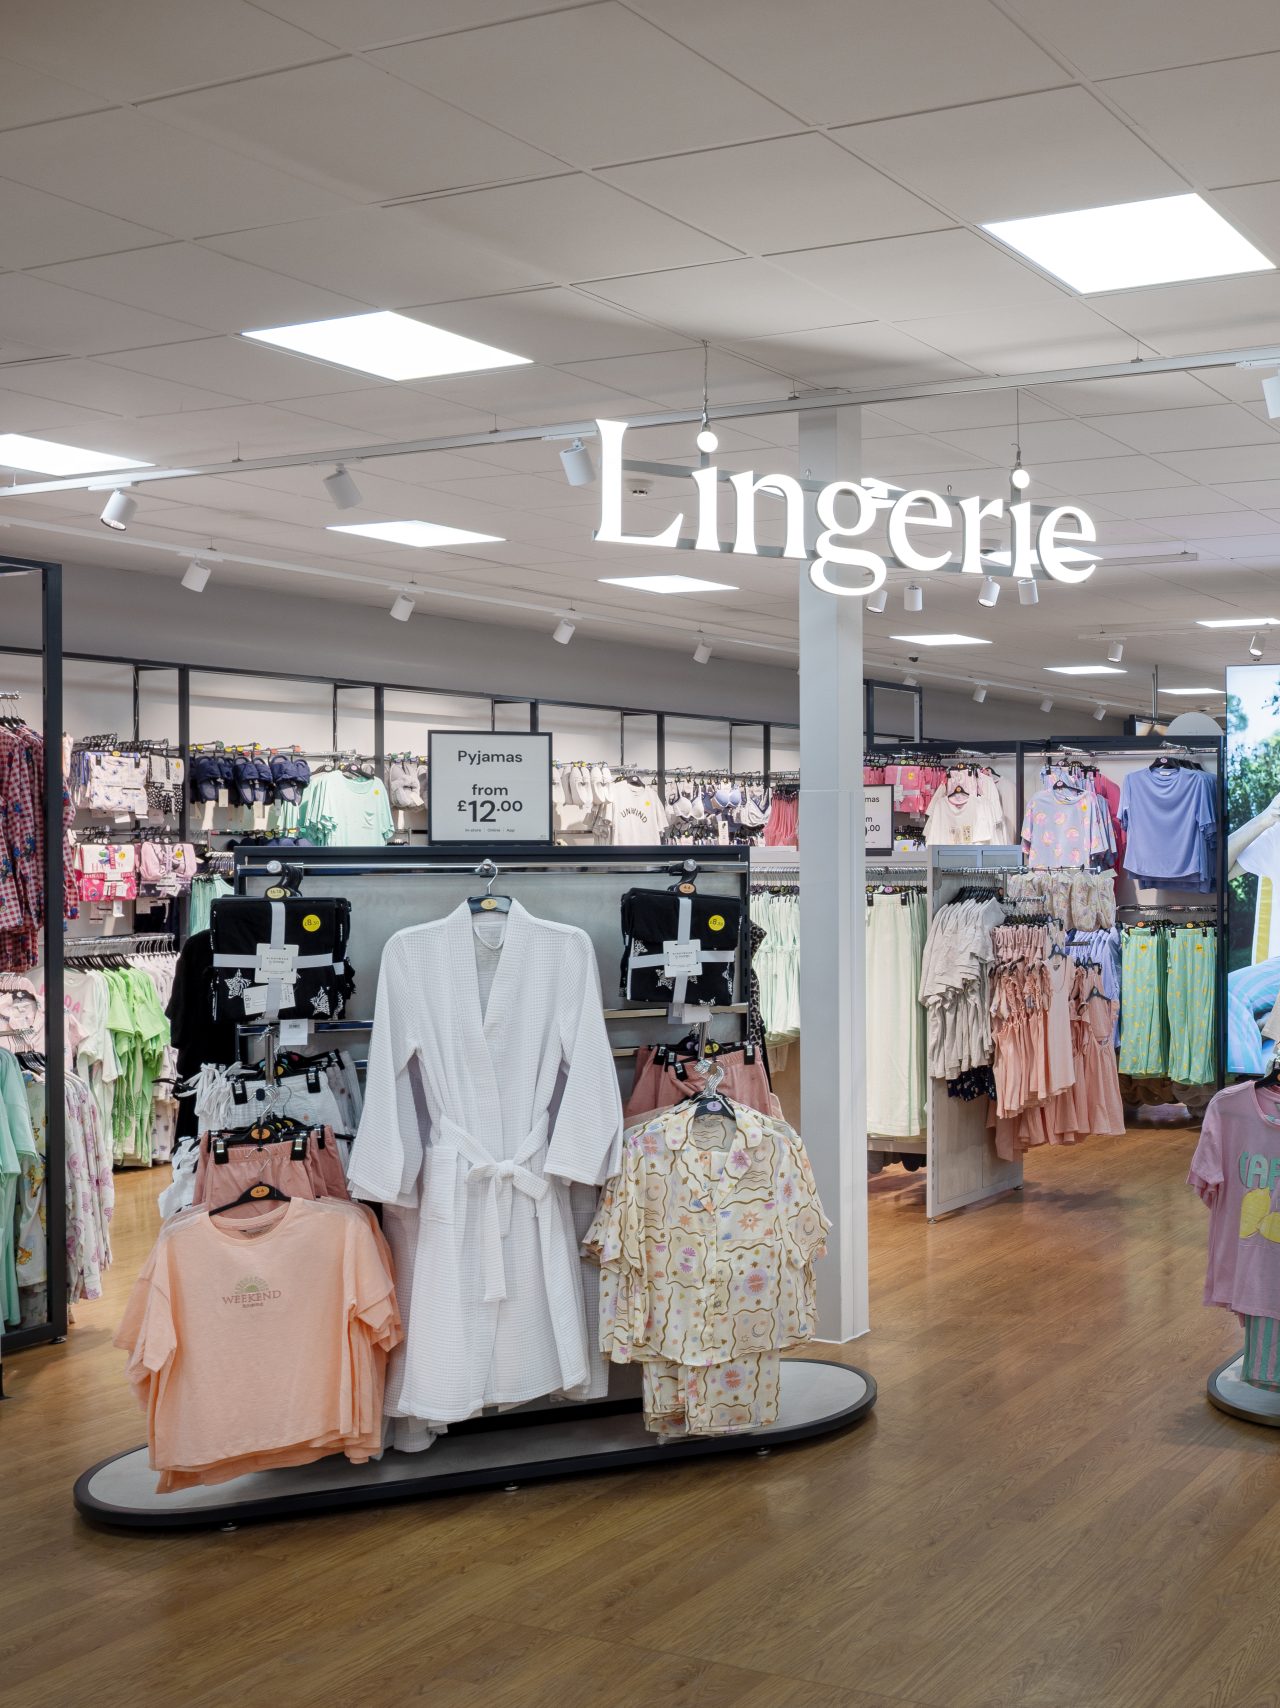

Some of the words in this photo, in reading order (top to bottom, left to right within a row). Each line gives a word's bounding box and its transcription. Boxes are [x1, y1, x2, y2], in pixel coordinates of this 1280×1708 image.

[594, 418, 1097, 597] Lingerie
[457, 750, 523, 765] Pyjamas
[472, 784, 508, 796] from
[457, 800, 523, 823] £12.00
[620, 807, 648, 823] UNWIND
[222, 1290, 282, 1304] WEEKEND
